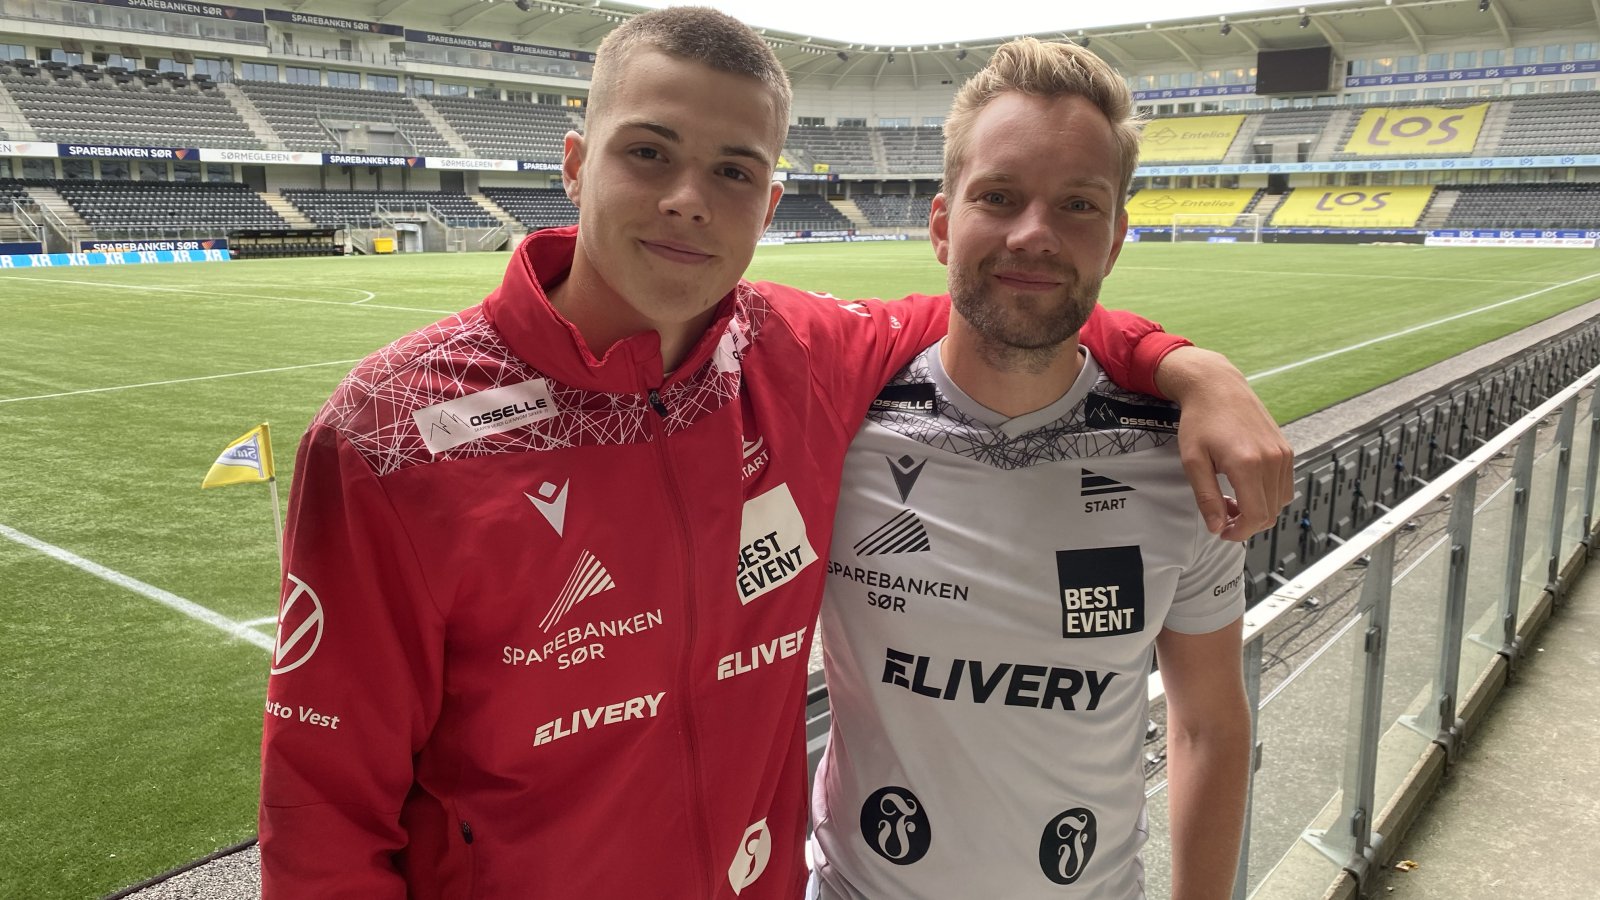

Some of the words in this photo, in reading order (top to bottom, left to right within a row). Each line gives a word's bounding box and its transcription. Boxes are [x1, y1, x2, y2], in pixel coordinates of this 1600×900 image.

[128, 0, 200, 13] SPAREBANKEN
[203, 7, 222, 16] SØR
[292, 14, 352, 28] SPAREBANKEN
[354, 22, 370, 30] SØR
[427, 34, 477, 46] SPAREBANKEN
[513, 45, 557, 56] SPAREBANKEN
[1486, 69, 1499, 77] LOS
[1523, 66, 1536, 74] LOS
[1562, 64, 1575, 72] LOS
[1367, 115, 1464, 146] LOS
[69, 146, 148, 158] SPAREBANKEN
[150, 149, 172, 158] SØR
[220, 152, 289, 161] SØRMEGLEREN
[330, 155, 388, 165] SPAREBANKEN
[390, 158, 405, 166] SØR
[440, 160, 492, 168] SØRMEGLEREN
[1316, 192, 1392, 211] LOS
[93, 242, 174, 251] SPAREBANKEN
[177, 242, 198, 250] SØR
[28, 254, 52, 266] XR
[66, 253, 90, 266] XR
[104, 252, 126, 265] XR
[138, 251, 159, 263] XR
[171, 250, 192, 262] XR
[203, 249, 223, 262] XR
[873, 399, 933, 410] OSSELLE
[470, 398, 548, 427] OSSELLE
[1120, 416, 1180, 428] OSSELLE
[742, 449, 769, 480] TART
[1084, 498, 1126, 513] START
[738, 545, 803, 598] EVENT
[827, 561, 969, 601] SPAREBANKEN
[867, 591, 906, 613] SØR
[1064, 585, 1120, 610] BEST
[1067, 608, 1134, 633] EVENT
[502, 608, 664, 666] SPAREBANKEN
[557, 642, 606, 670] SØR
[882, 648, 1120, 710] ELIVERY
[266, 698, 292, 719] uto
[298, 706, 340, 730] Vest
[533, 691, 666, 747] ELIVERY
